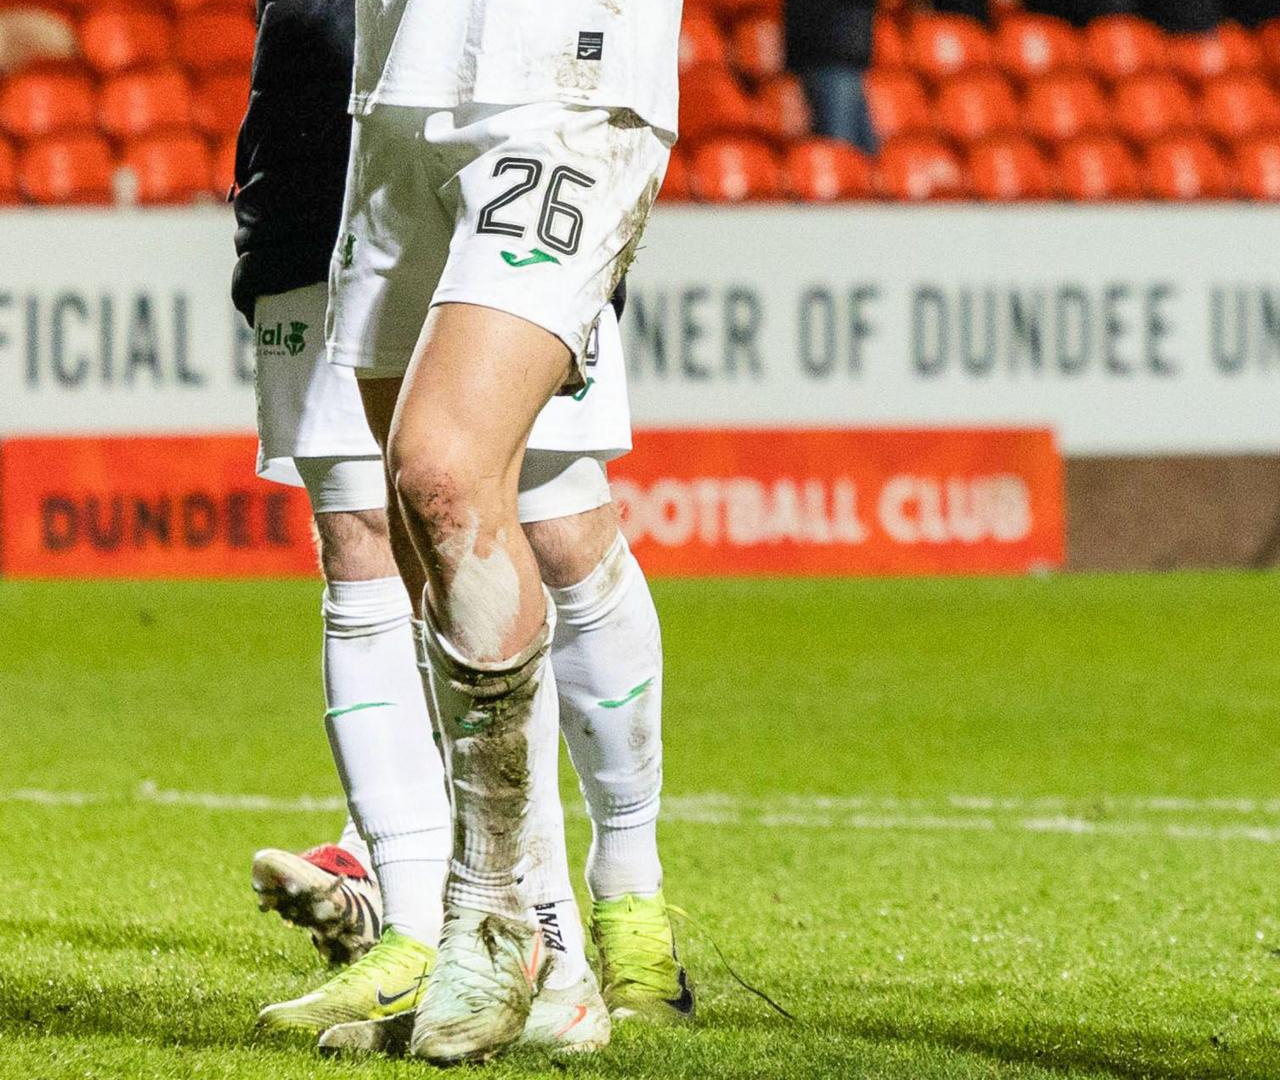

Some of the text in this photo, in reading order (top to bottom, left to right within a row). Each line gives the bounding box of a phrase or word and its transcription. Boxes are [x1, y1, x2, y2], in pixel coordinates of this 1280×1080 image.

[476, 156, 597, 256] 26
[800, 283, 878, 379] OF
[911, 281, 1180, 378] DUNDEE
[41, 473, 1032, 552] DUNDEE OOTBALL CLUB
